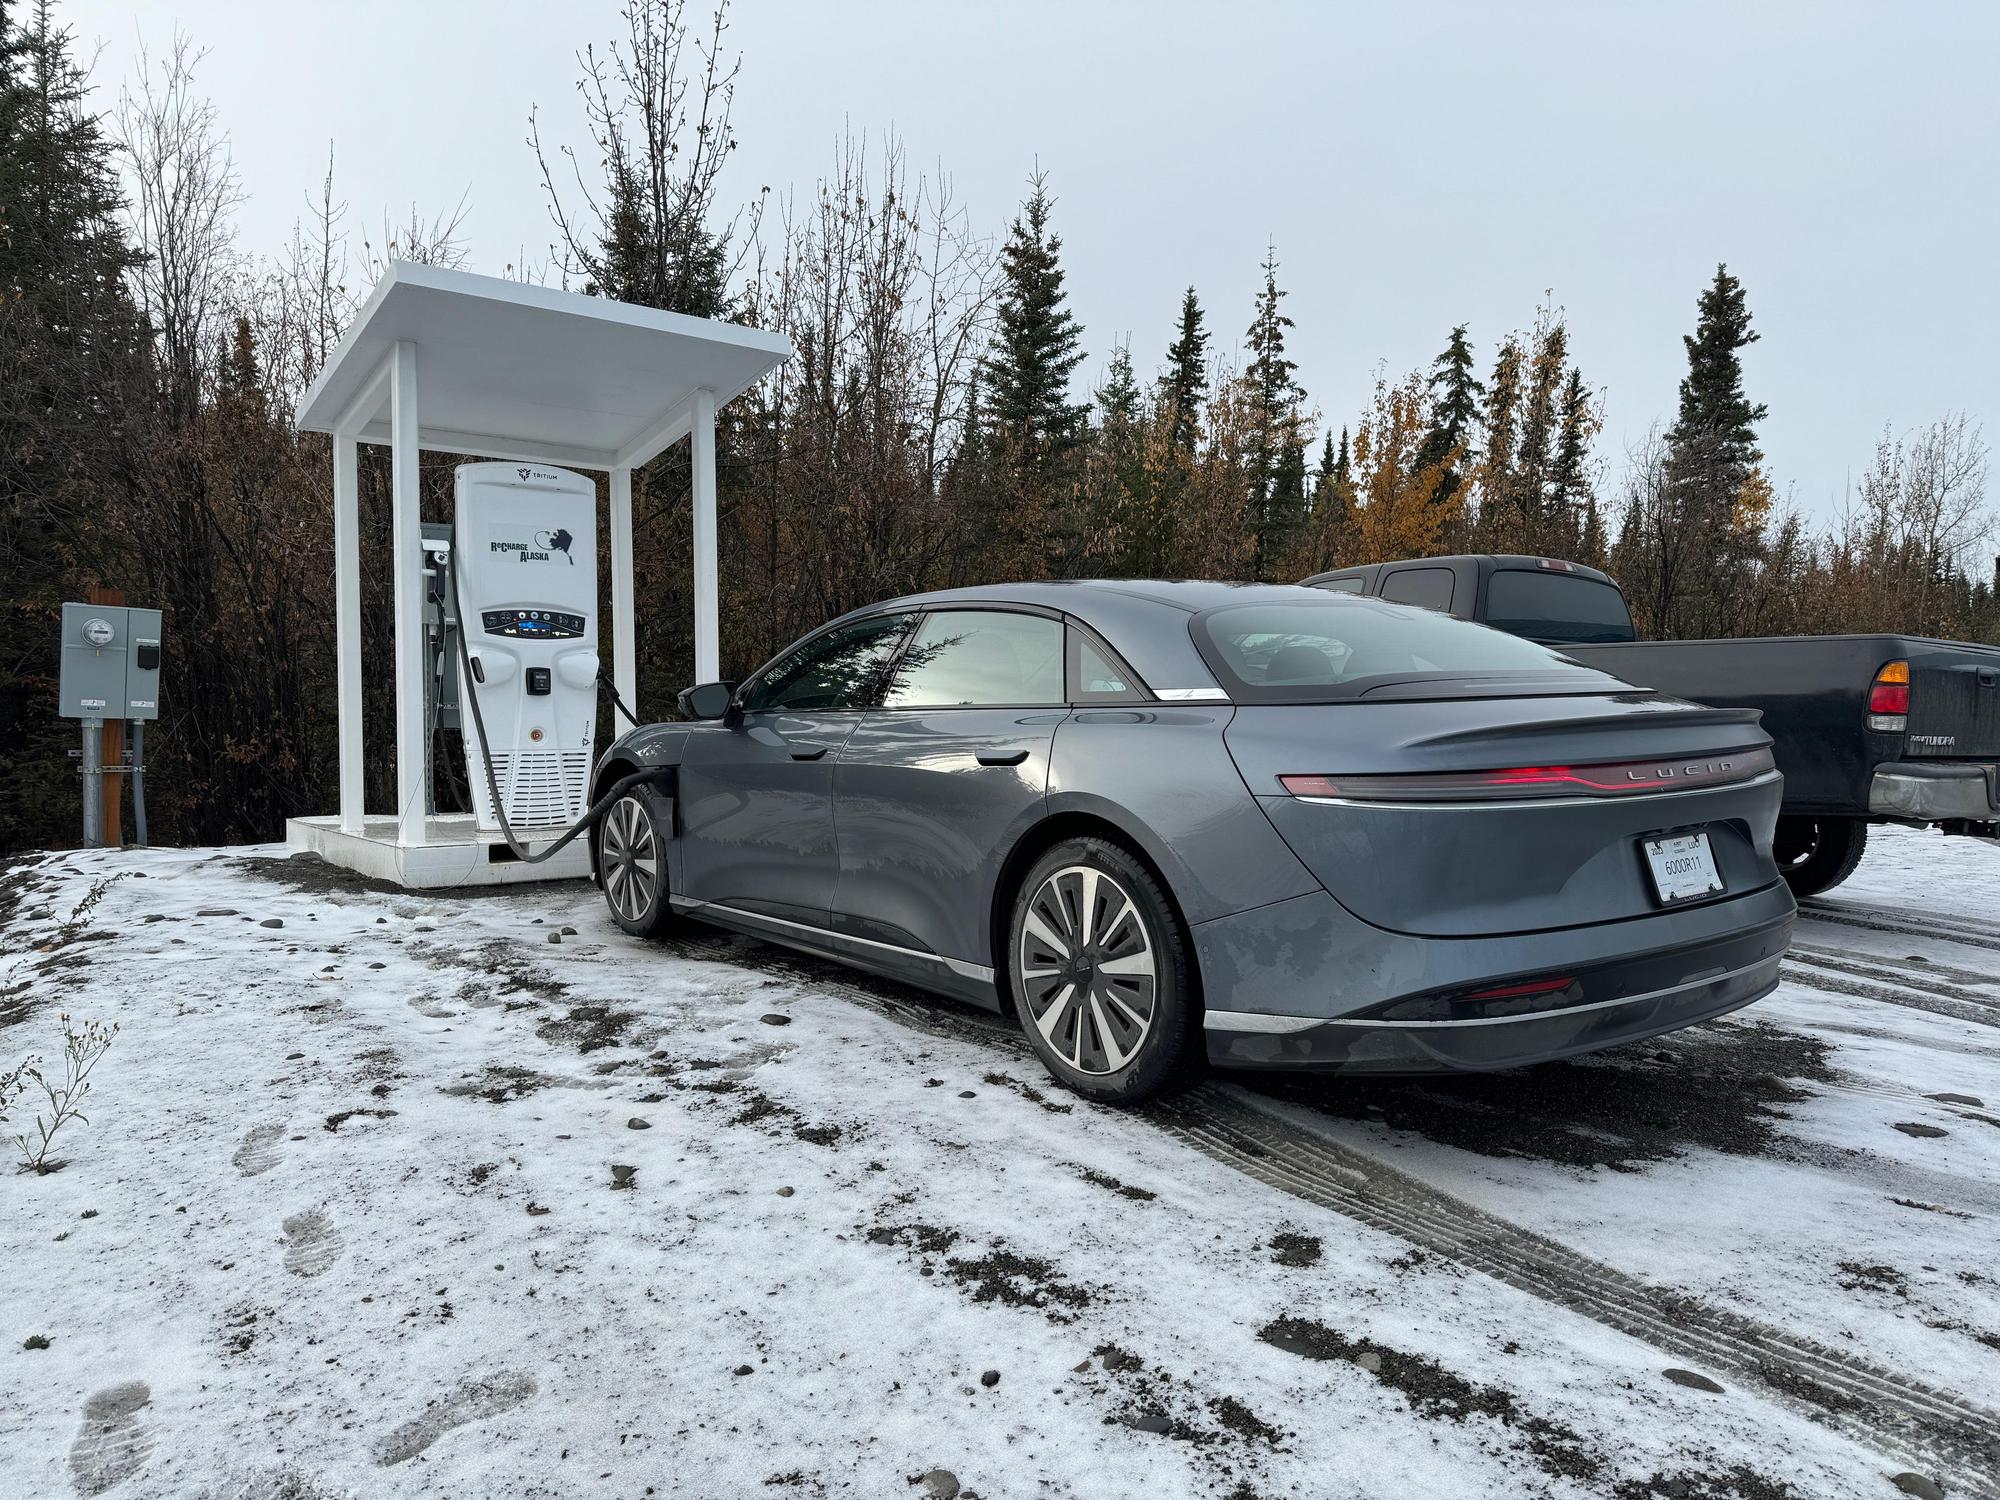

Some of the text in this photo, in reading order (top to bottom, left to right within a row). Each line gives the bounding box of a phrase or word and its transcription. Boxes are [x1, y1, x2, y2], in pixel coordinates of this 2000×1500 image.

[533, 472, 558, 480] TRITIUM
[520, 551, 549, 562] ALASKA
[1627, 762, 1733, 780] LUCID
